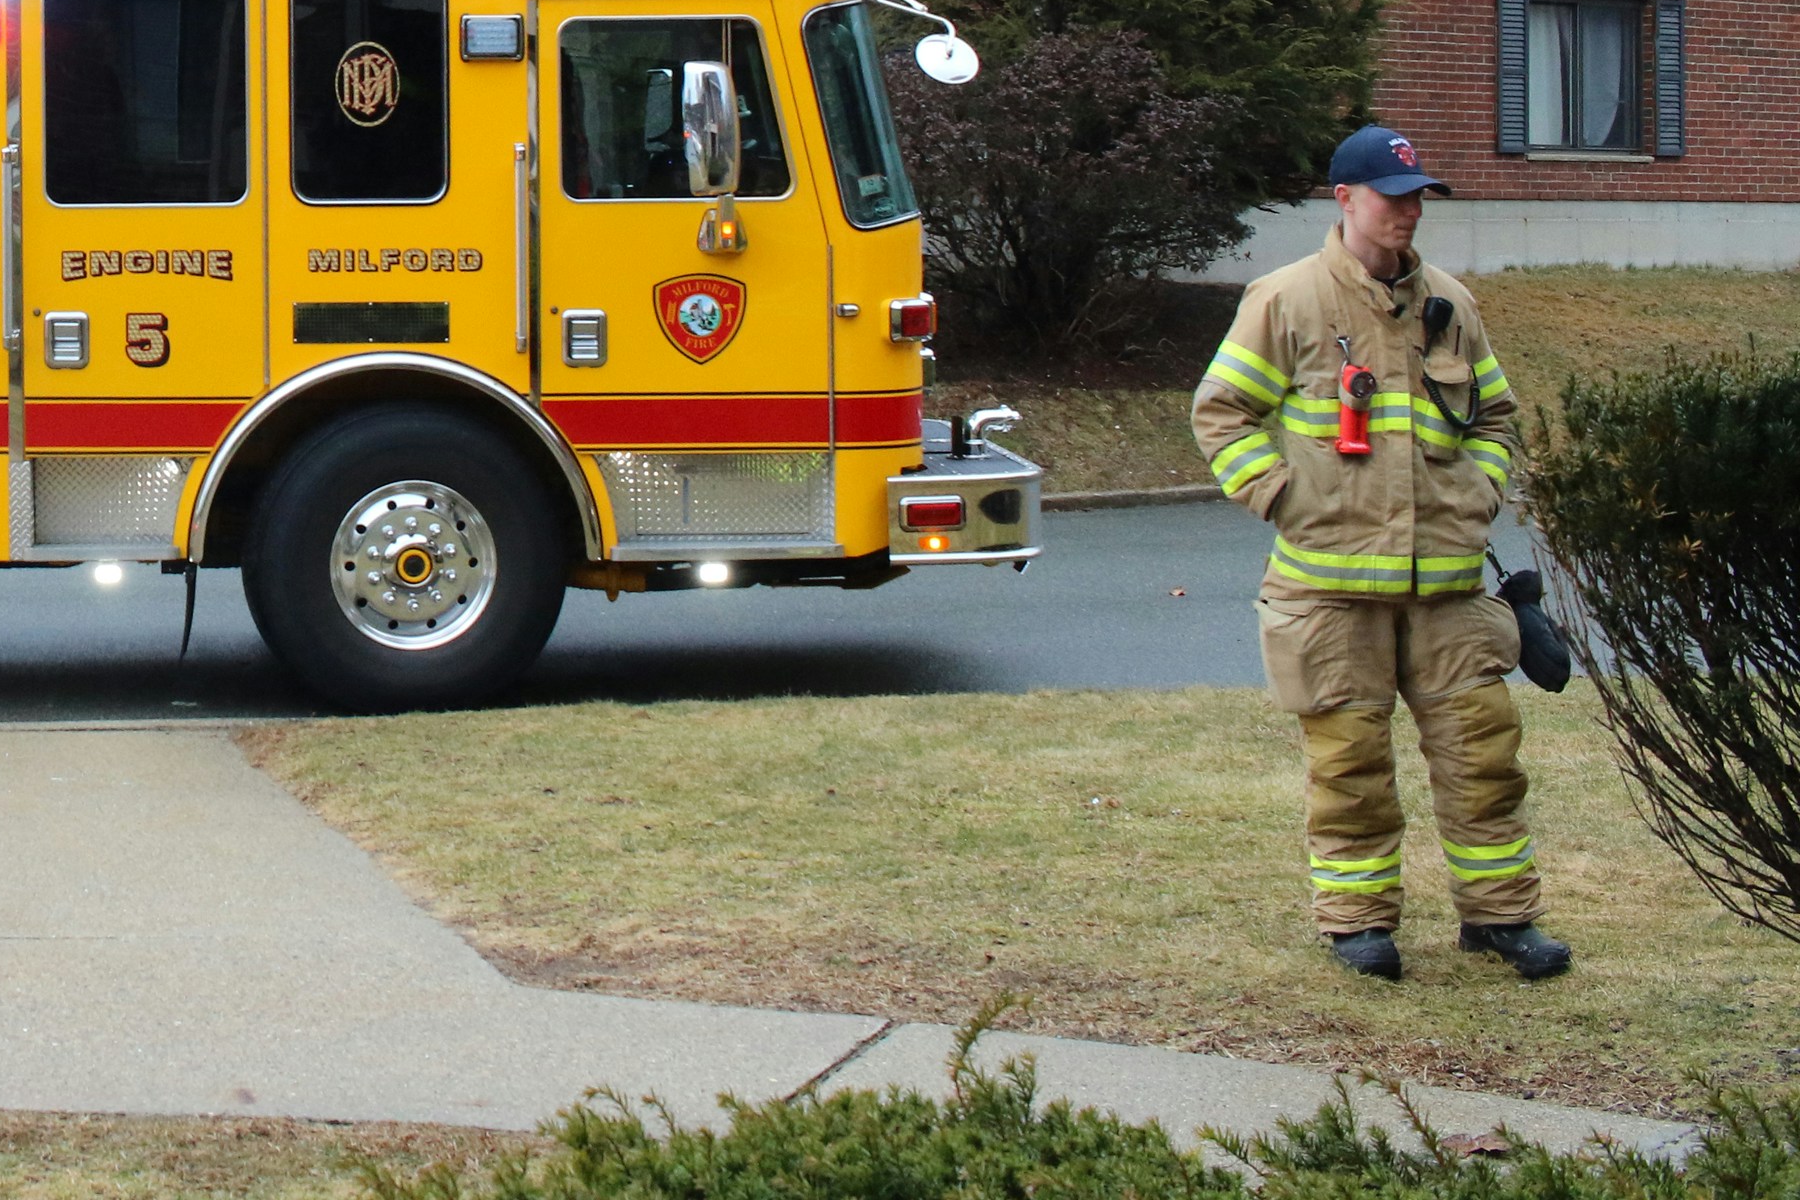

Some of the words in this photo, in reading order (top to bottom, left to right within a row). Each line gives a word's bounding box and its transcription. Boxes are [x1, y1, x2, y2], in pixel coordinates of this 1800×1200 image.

[61, 249, 233, 281] ENGINE
[307, 248, 483, 273] MILFORD
[672, 281, 729, 298] MILFORD
[125, 312, 171, 367] 5
[685, 337, 716, 349] FIRE
